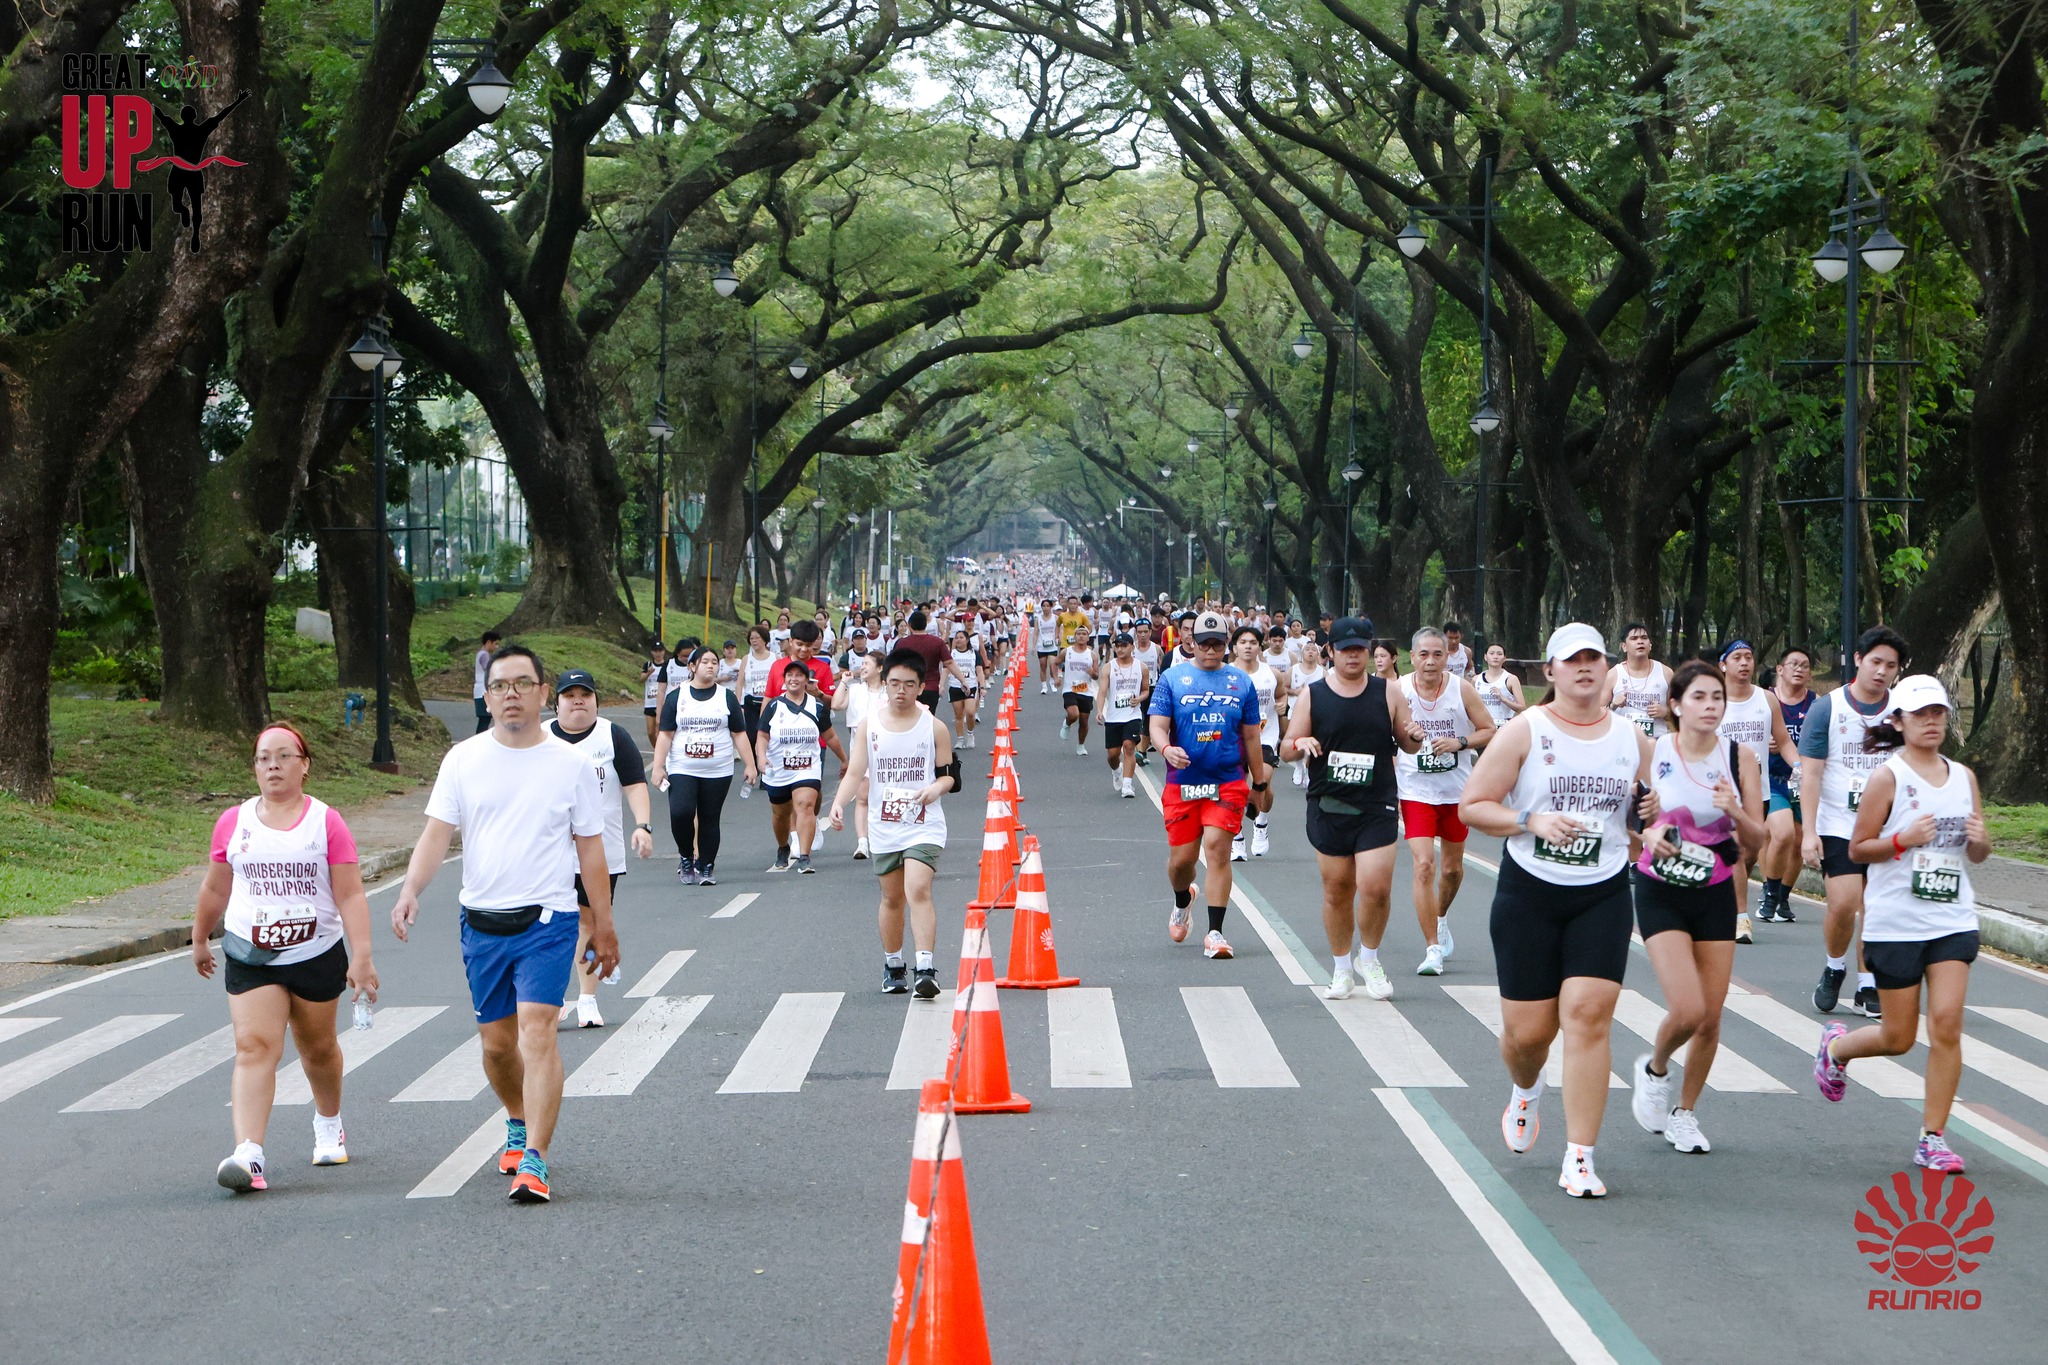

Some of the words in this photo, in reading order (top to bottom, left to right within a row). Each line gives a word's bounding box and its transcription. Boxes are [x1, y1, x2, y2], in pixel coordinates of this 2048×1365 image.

[1192, 712, 1226, 723] LABX
[1184, 784, 1216, 798] 13605
[242, 862, 318, 879] UNIBERSIDAD
[264, 880, 318, 896] PILIPINAS
[258, 923, 310, 944] 52971
